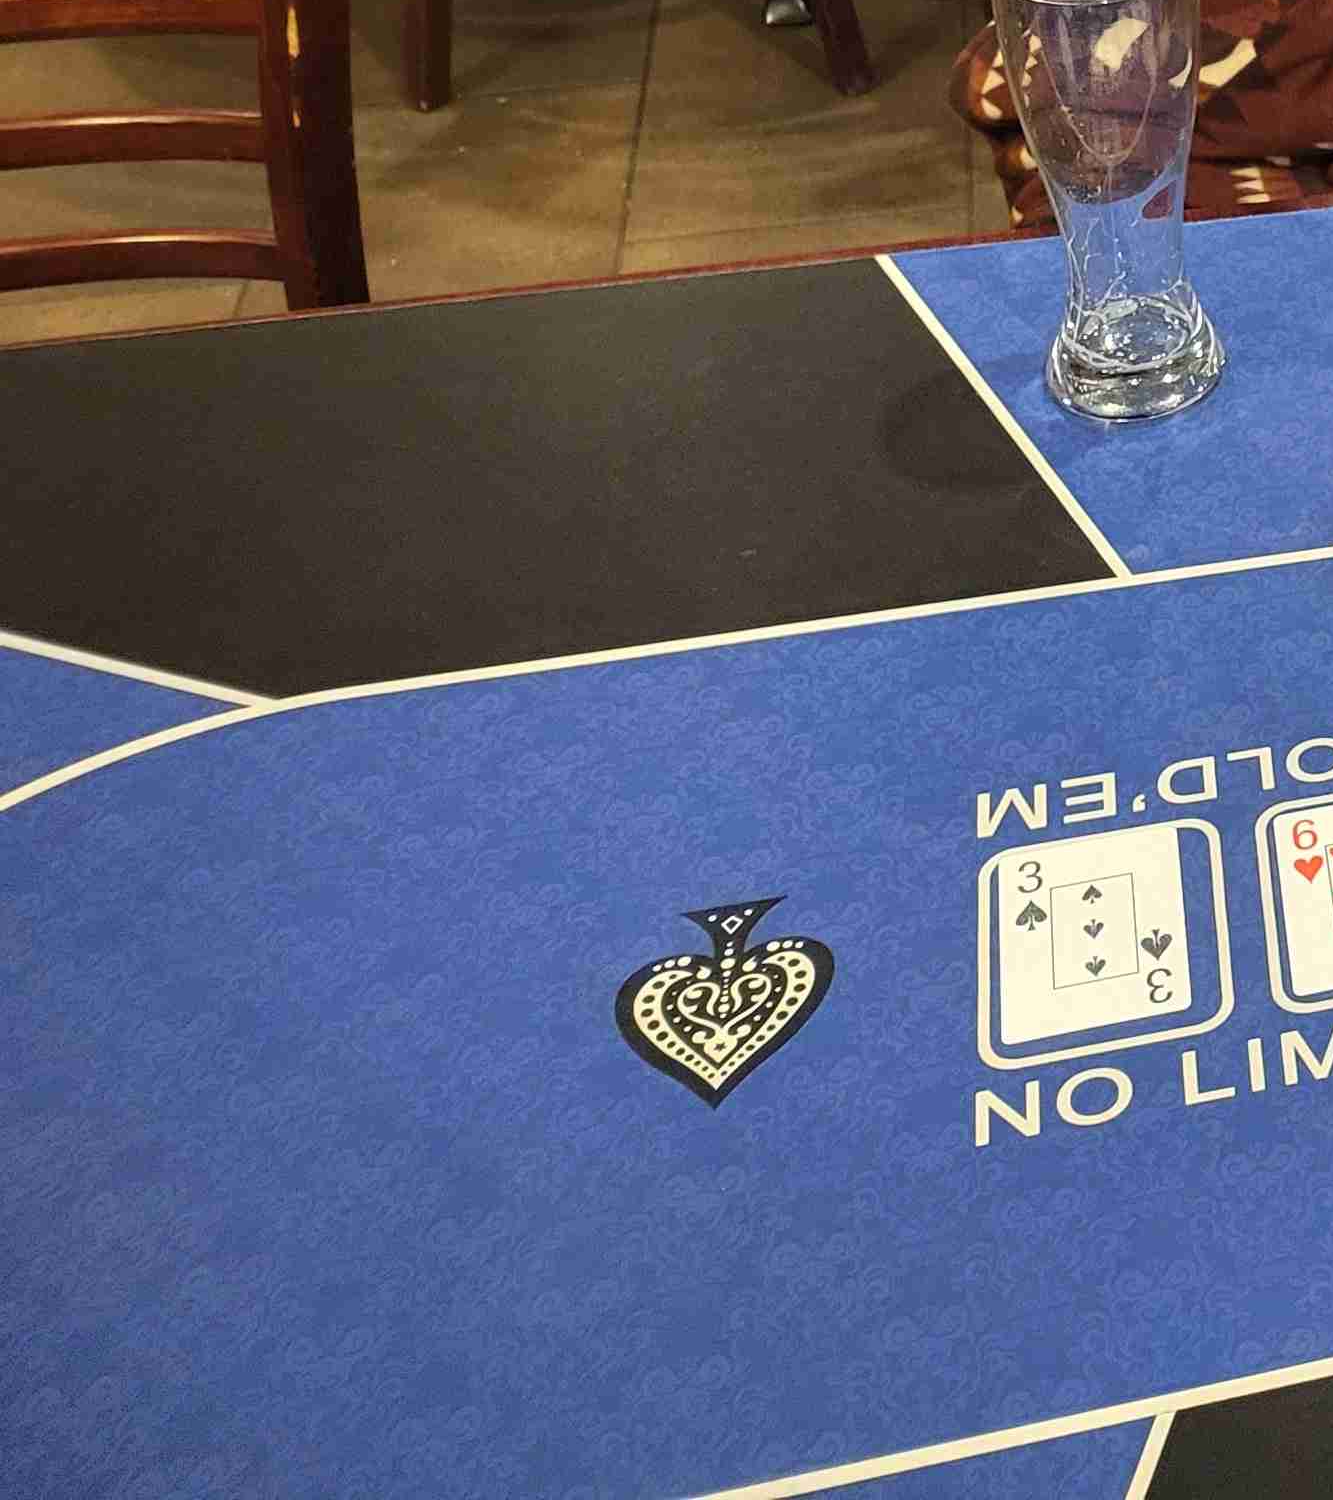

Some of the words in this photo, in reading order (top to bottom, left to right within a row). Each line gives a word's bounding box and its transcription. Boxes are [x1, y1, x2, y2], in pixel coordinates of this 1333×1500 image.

[1292, 819, 1318, 851] 6
[1017, 861, 1043, 894] 3
[1146, 968, 1173, 1004] 3
[975, 1067, 1133, 1147] NO
